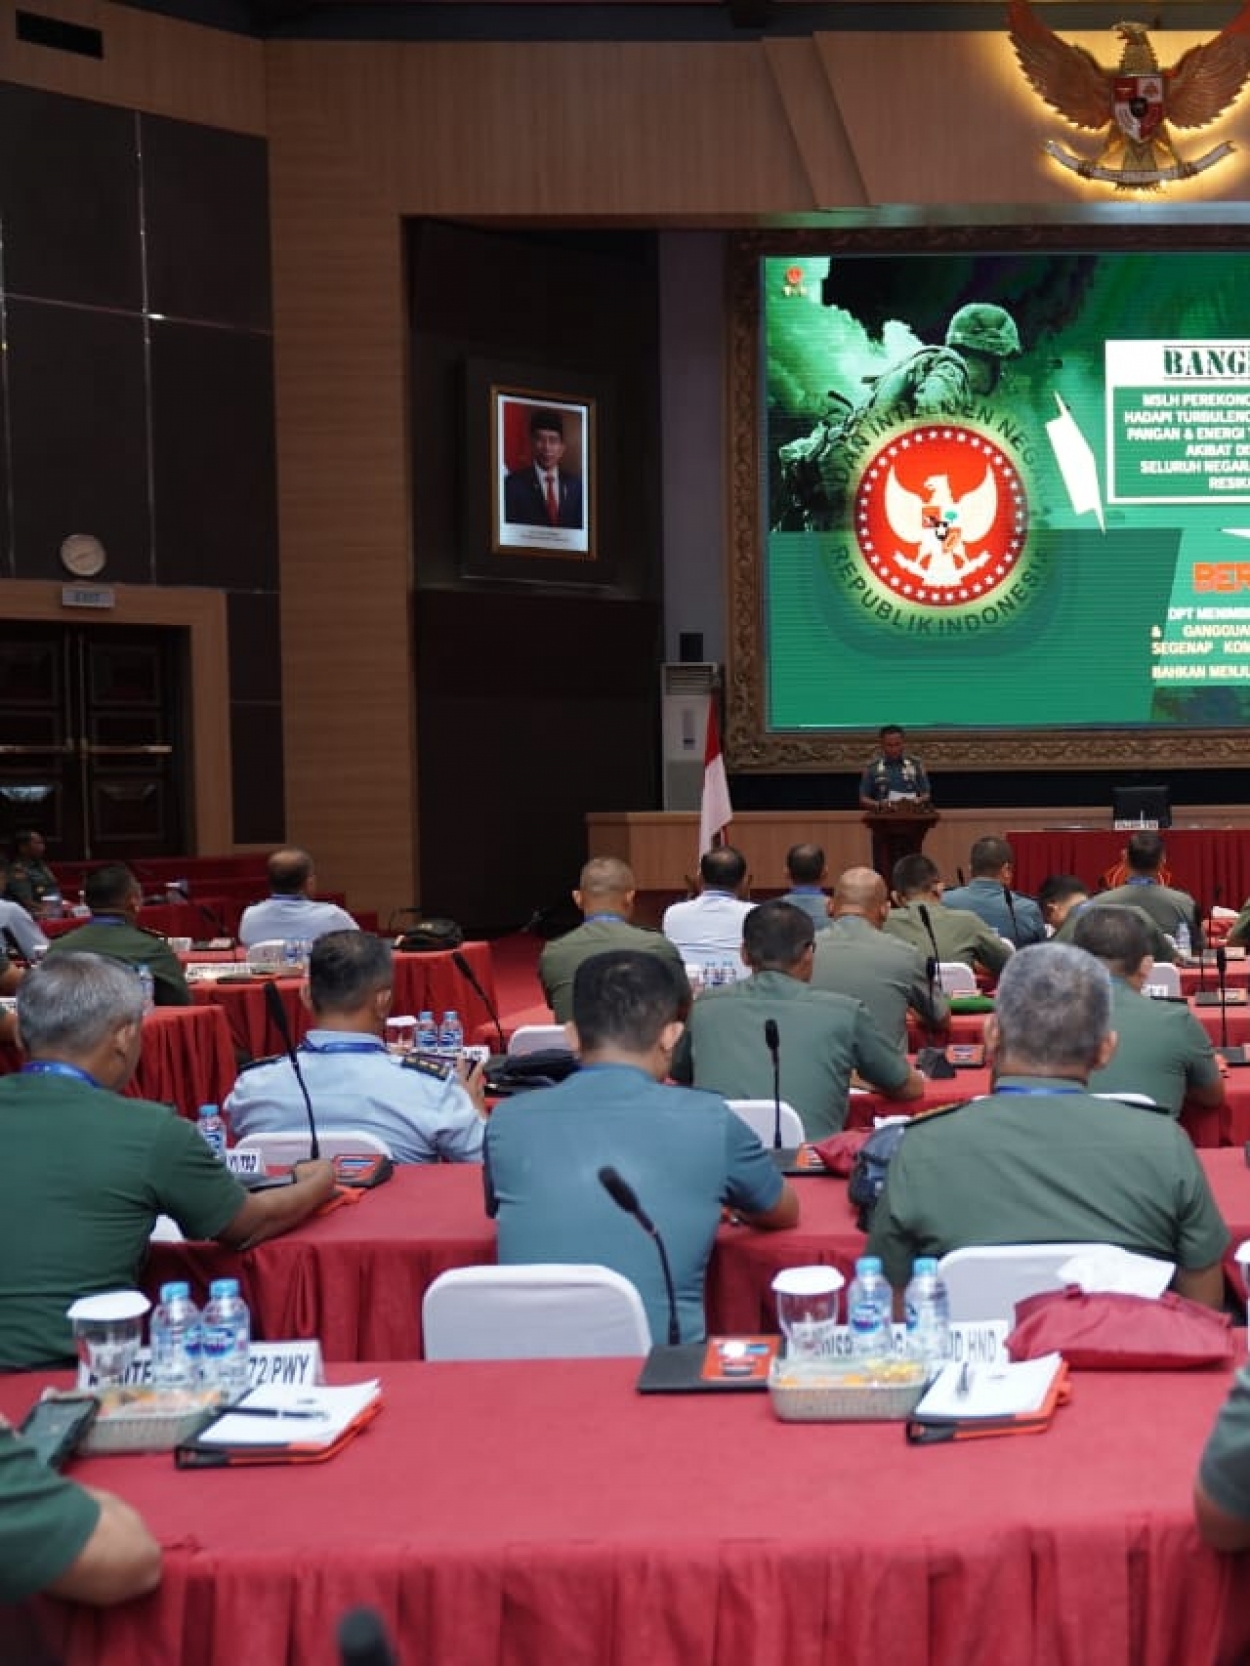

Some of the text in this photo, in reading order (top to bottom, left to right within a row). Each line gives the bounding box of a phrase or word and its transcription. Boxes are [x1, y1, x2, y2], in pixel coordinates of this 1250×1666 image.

[1124, 410, 1173, 423] HADAPI
[1126, 427, 1181, 441] PANGAN
[1183, 427, 1194, 440] &
[1196, 427, 1245, 440] ENERGI
[1185, 443, 1233, 457] AKIBAT
[1140, 460, 1202, 474] SELURUH
[831, 545, 933, 632] REPUBLIK
[1168, 606, 1194, 621] DPT
[1151, 624, 1163, 638] &
[1151, 641, 1214, 655] SEGENAP
[1151, 665, 1206, 680] BAHKAN
[272, 1353, 310, 1386] PWY
